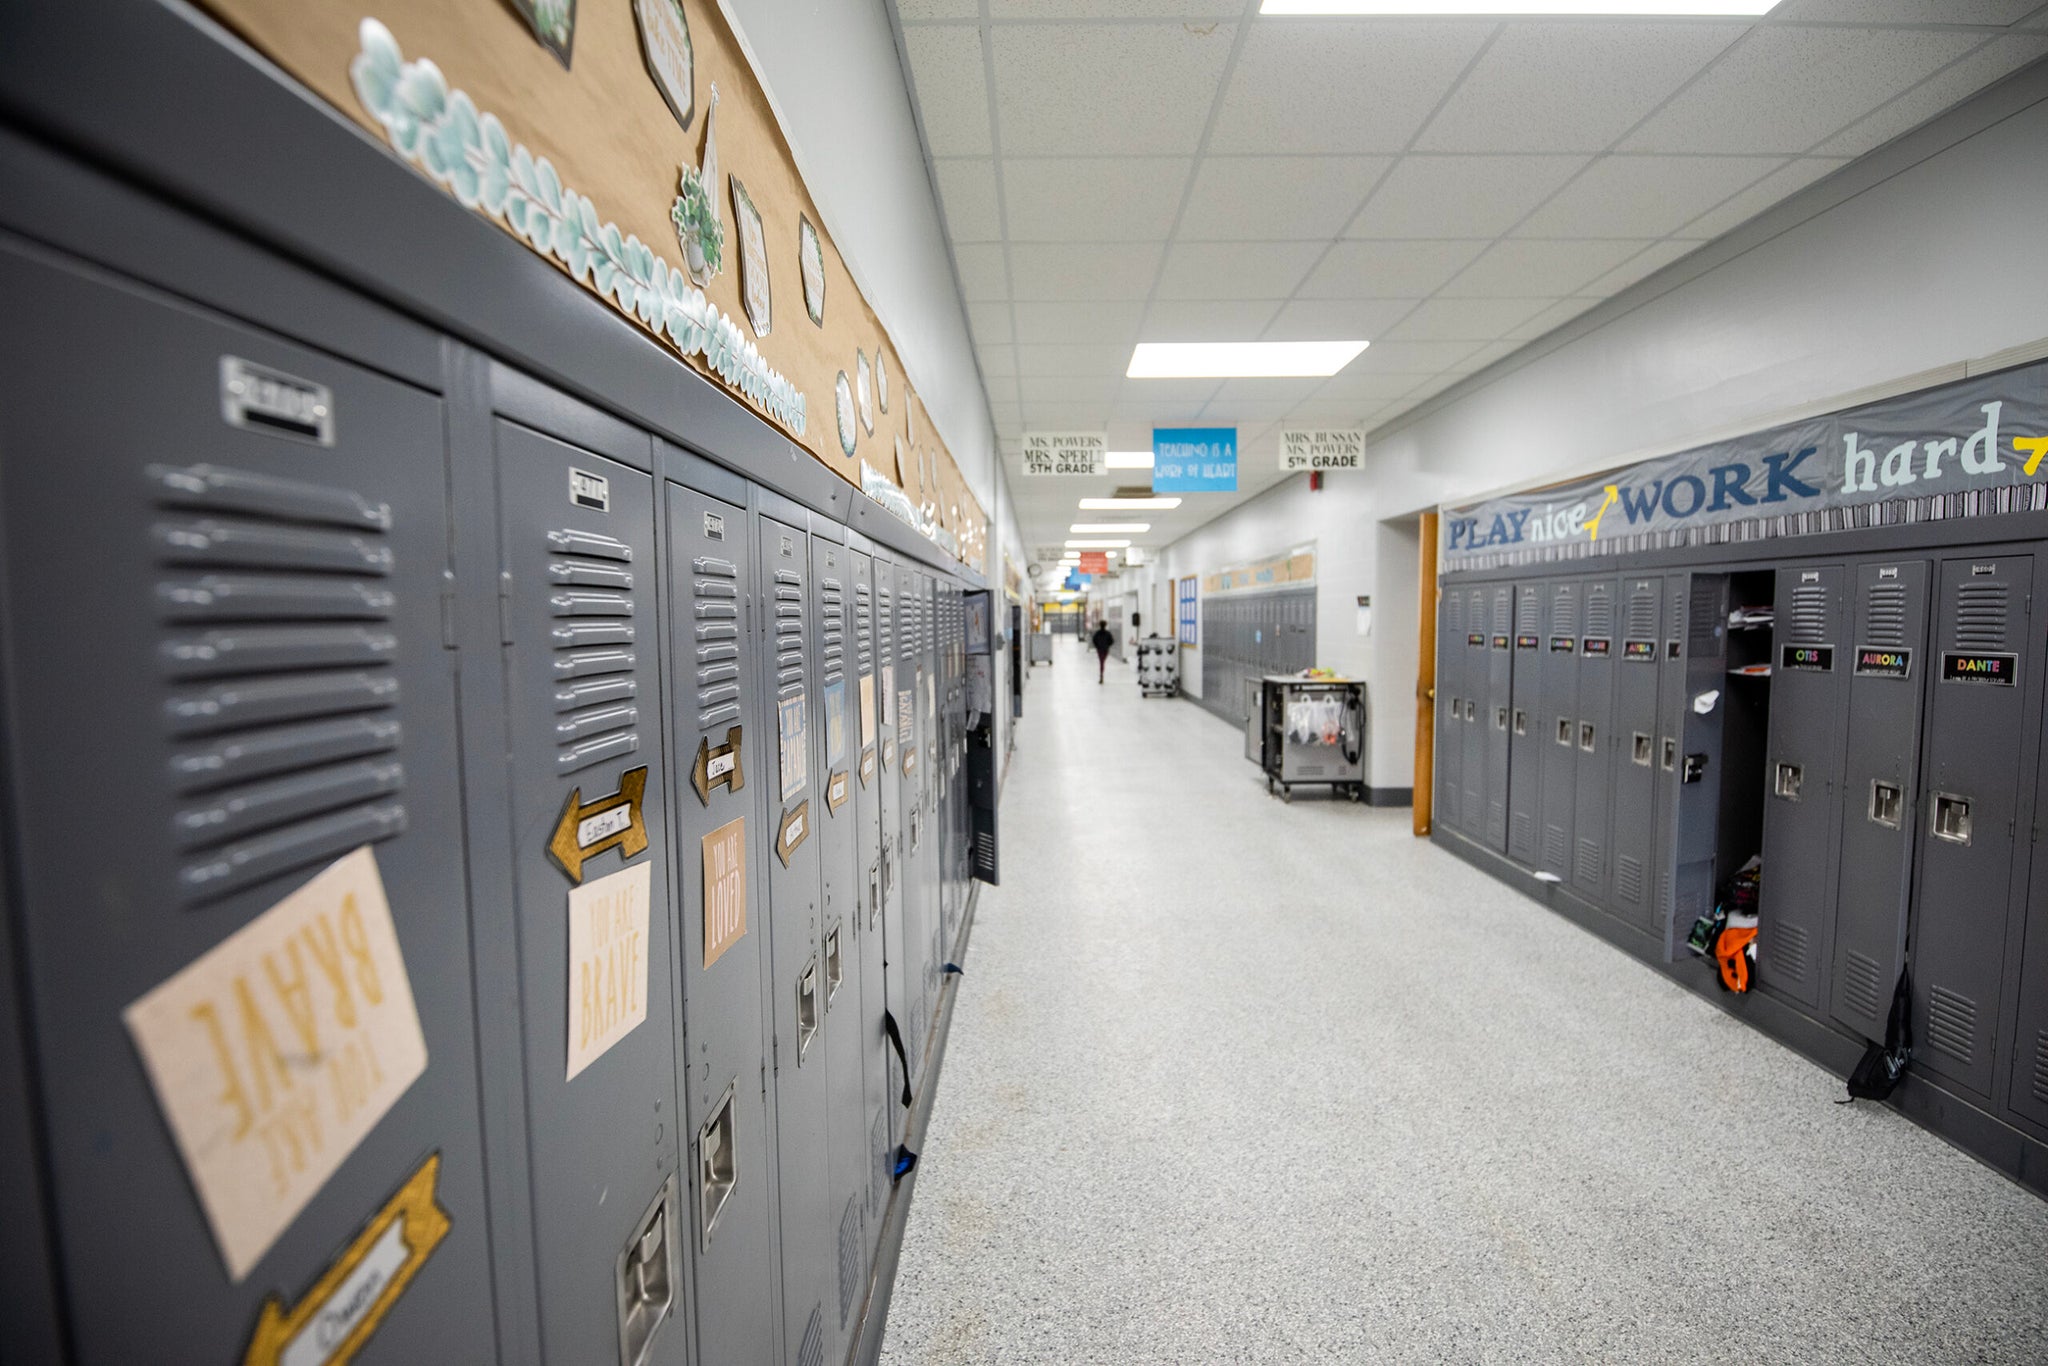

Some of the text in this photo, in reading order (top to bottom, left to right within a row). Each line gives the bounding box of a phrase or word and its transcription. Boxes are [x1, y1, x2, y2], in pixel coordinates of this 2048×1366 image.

[1053, 436, 1102, 448] POWERS
[1160, 442, 1232, 457] TEACHING IS A
[1310, 444, 1359, 454] POWERS
[1030, 463, 1100, 473] 5TH GRADE
[1288, 455, 1358, 468] 5TH GRADE
[1155, 465, 1182, 478] WORK
[1203, 463, 1235, 478] HEART
[1449, 400, 2006, 550] PLAY nice WORK hard
[1796, 650, 1818, 662] OTIS
[1863, 653, 1903, 667] AURORA
[1957, 659, 2000, 673] DANTE
[713, 832, 738, 881] YOU ARE
[589, 883, 634, 950] YOU ARE
[712, 869, 741, 950] LOVED
[581, 930, 639, 1051] BRAVE
[188, 890, 384, 1145] BRAVE
